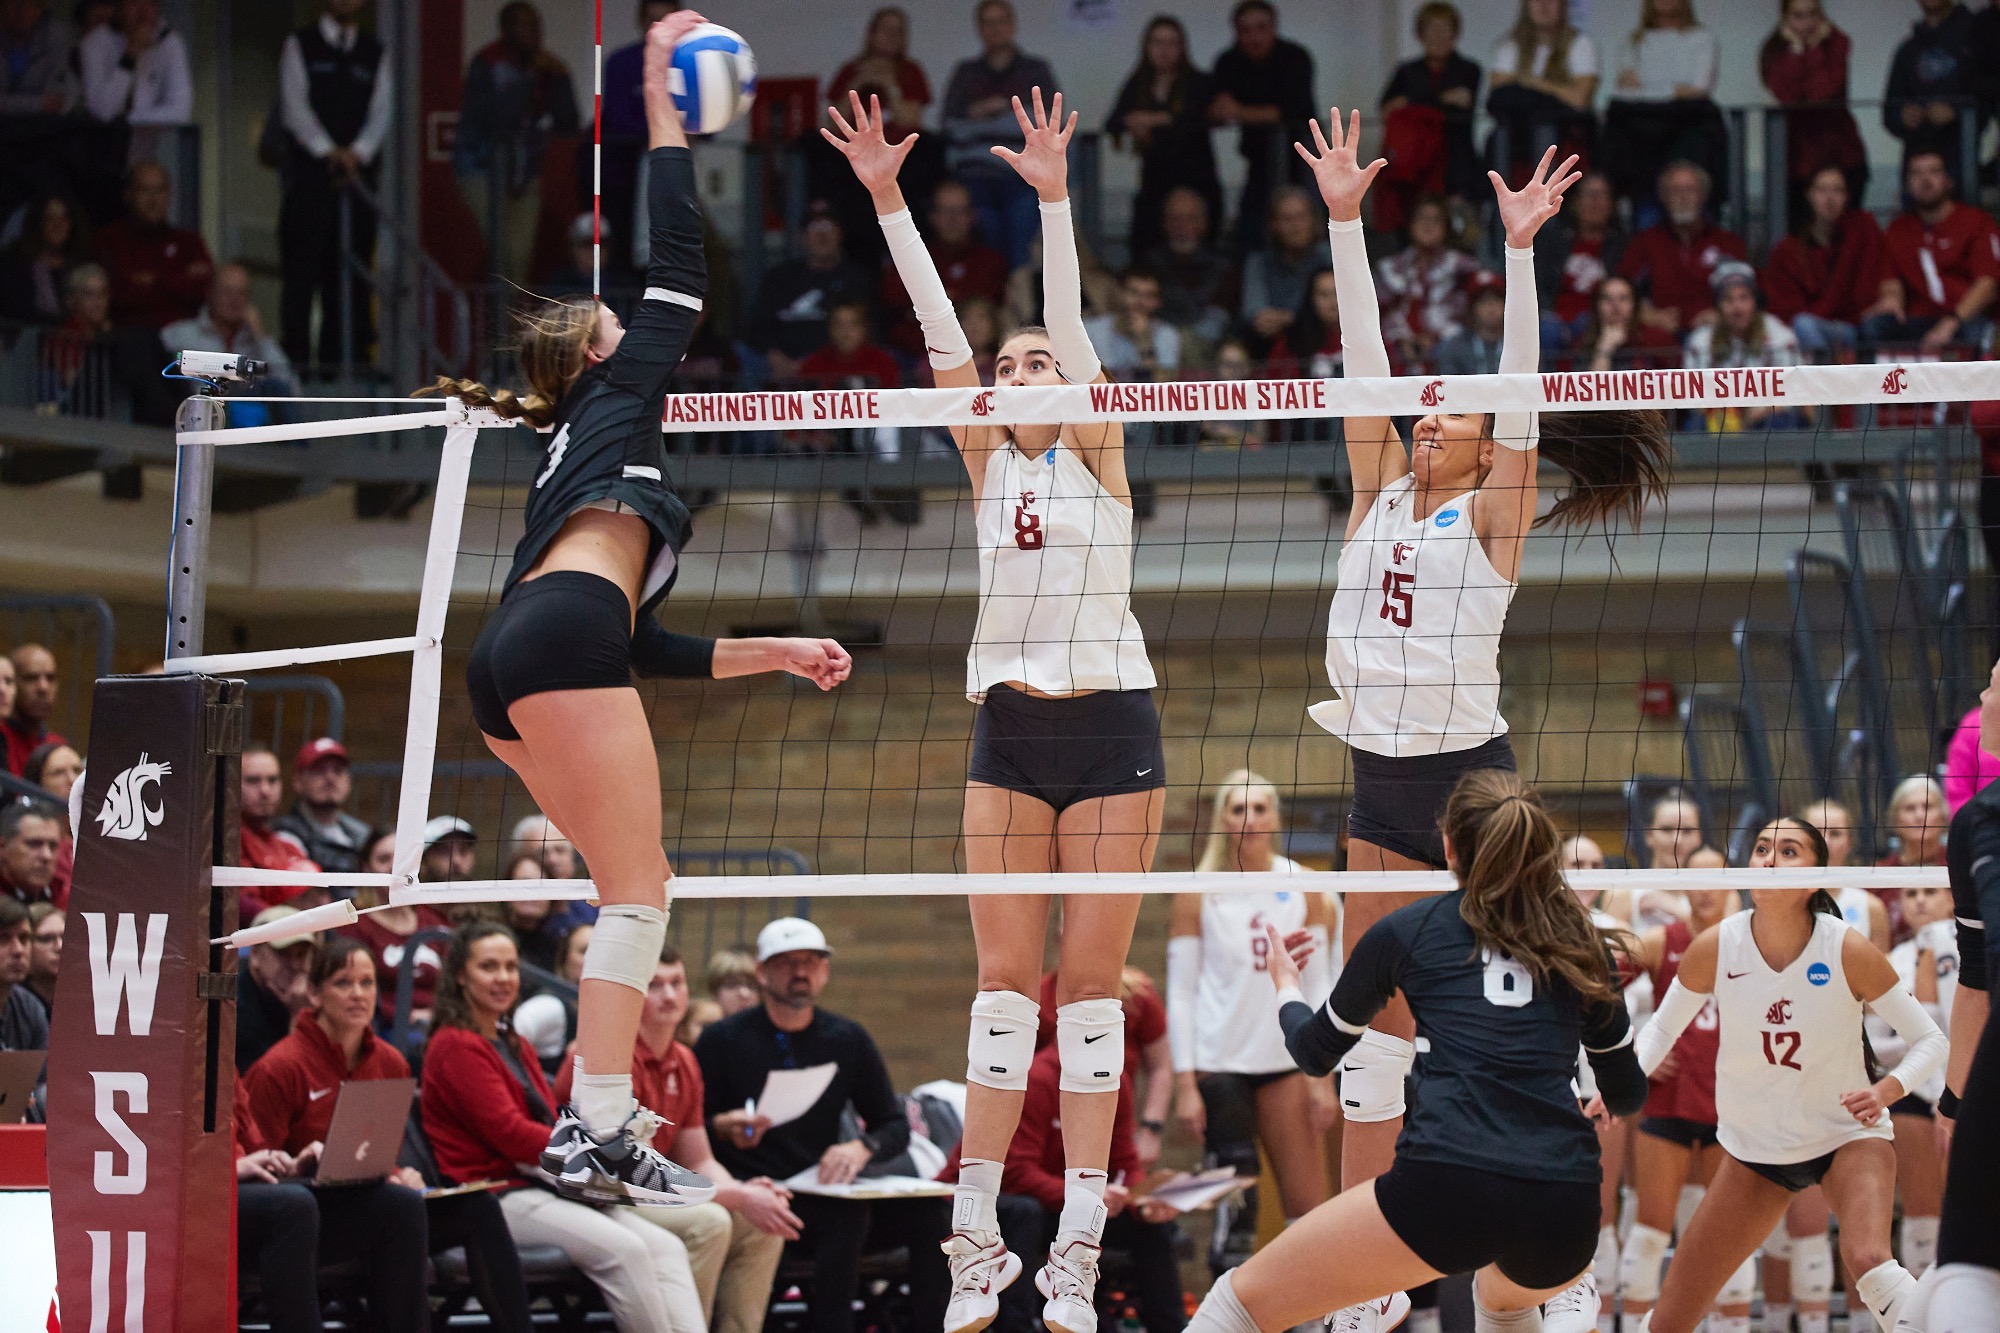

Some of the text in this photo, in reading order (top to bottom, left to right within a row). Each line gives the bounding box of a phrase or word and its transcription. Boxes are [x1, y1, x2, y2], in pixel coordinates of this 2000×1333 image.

[1090, 381, 1326, 412] WASHINGTON STATE
[1542, 369, 1786, 402] WASHINGTON STATE
[812, 391, 879, 420] STATE
[1015, 506, 1042, 550] 8
[1380, 569, 1414, 627] 15
[1810, 973, 1829, 981] NCAA
[1761, 1031, 1802, 1071] 12
